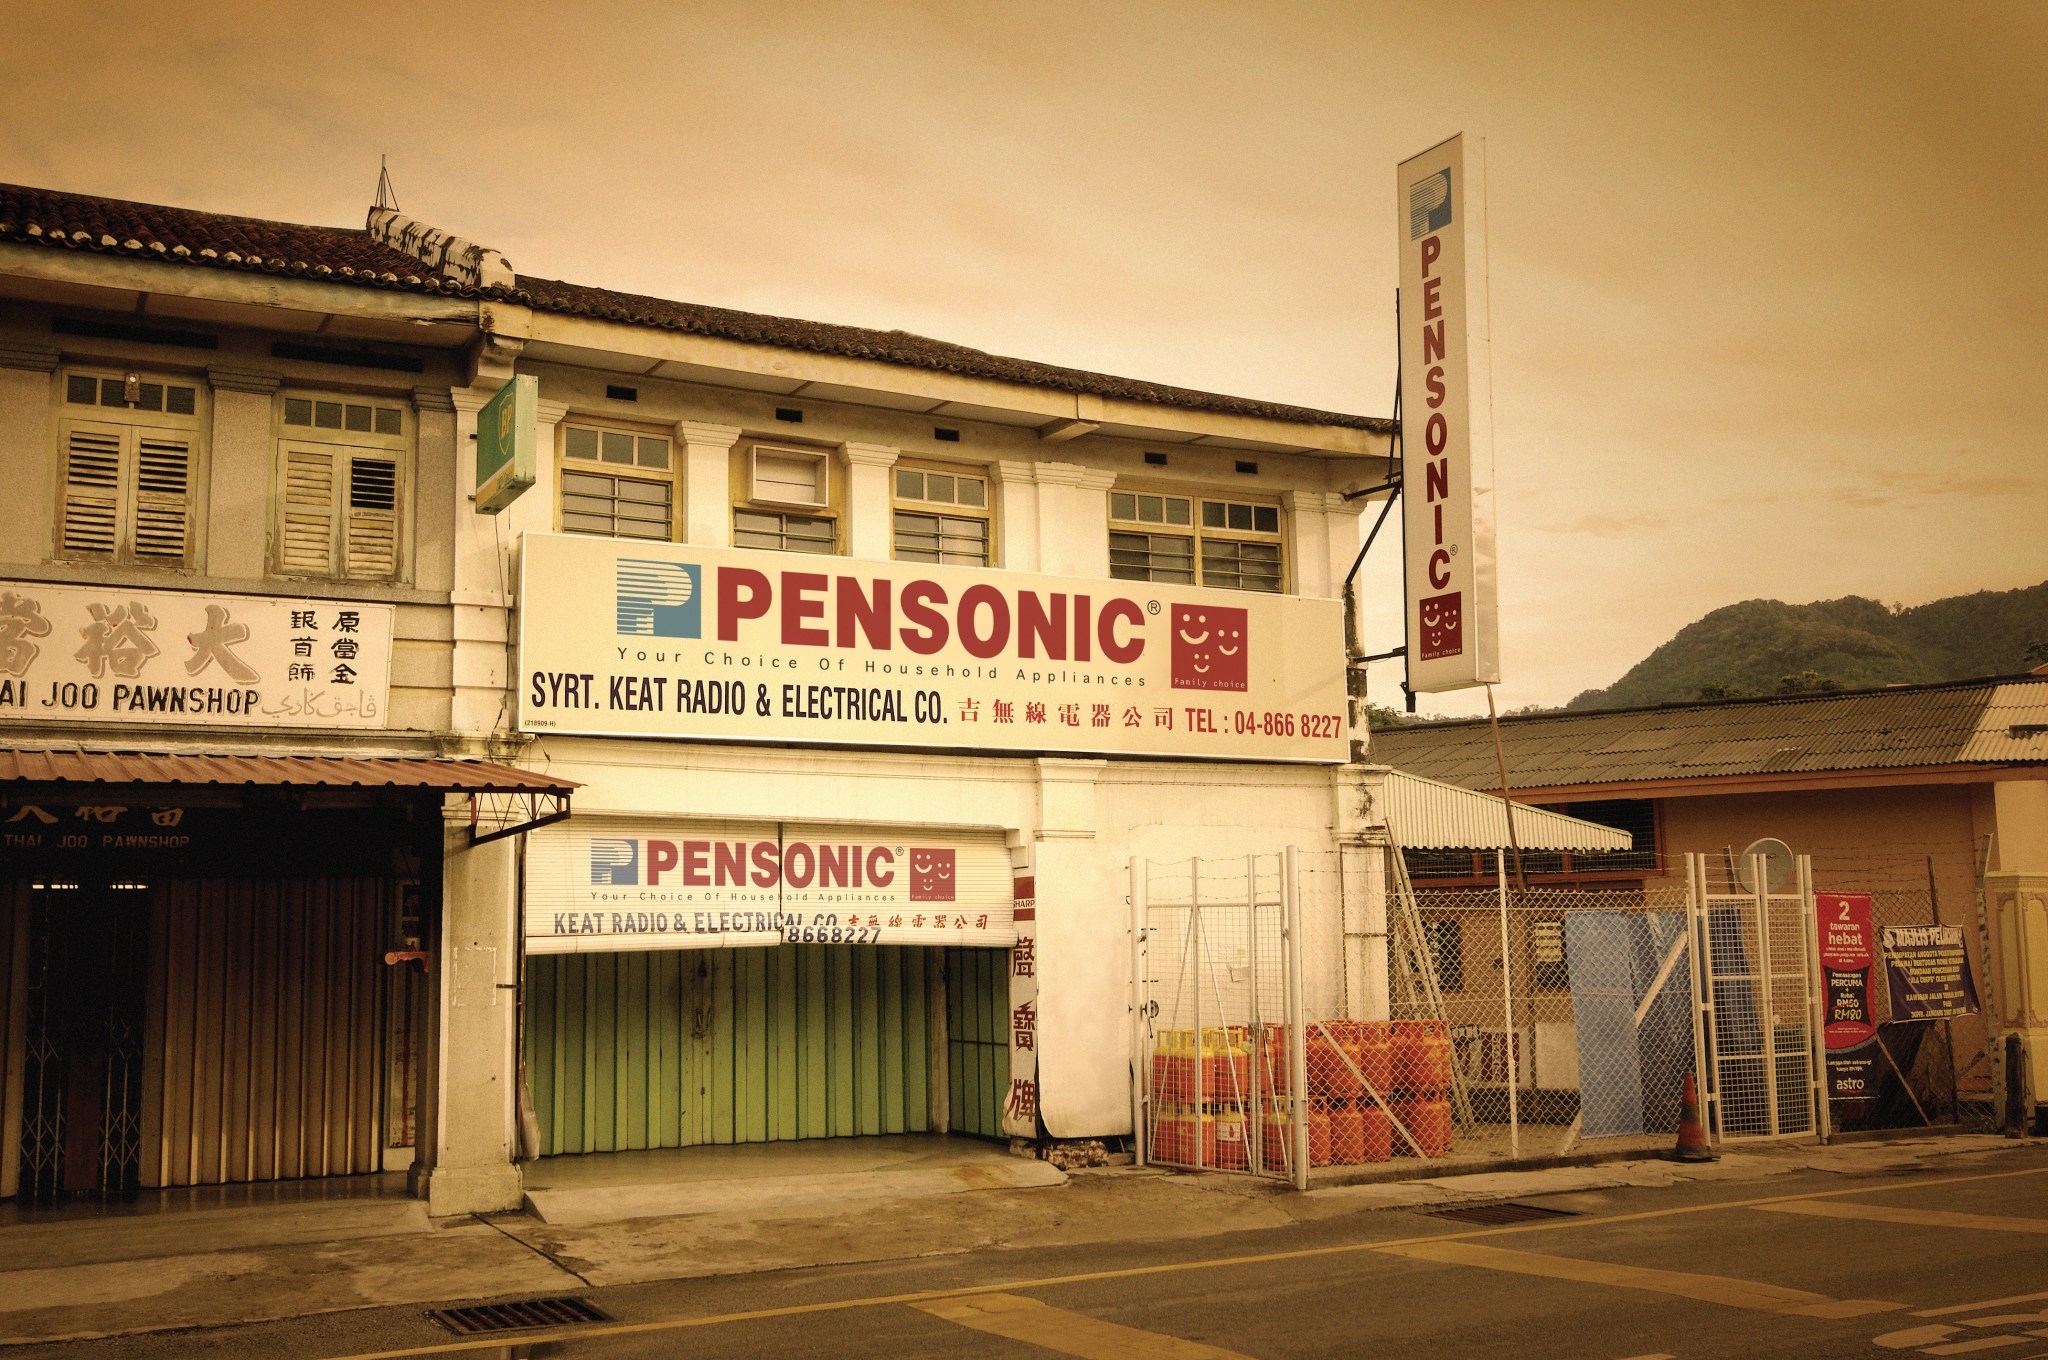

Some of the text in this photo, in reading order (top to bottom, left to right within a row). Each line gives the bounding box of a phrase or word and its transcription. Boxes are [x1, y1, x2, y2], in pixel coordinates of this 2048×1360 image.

[1420, 235, 1451, 590] PENSONIC
[717, 566, 1146, 664] PENSONIC
[1421, 646, 1461, 660] Family choice
[617, 647, 1147, 687] Your Choice Of Household Appliances
[1174, 677, 1246, 689] Family choice
[42, 682, 98, 709] JOO
[113, 684, 260, 716] PAWNSHOP
[531, 671, 949, 724] SYRT. KEAT RADIO & ELECTRICAL CO.
[957, 698, 1175, 731] 吉無線電器公司
[1234, 710, 1295, 738] 04-866
[1300, 713, 1342, 739] 8227
[5, 834, 190, 849] THAI JOO PAWNSHOP
[647, 840, 895, 888] PENSONIC
[591, 892, 628, 901] Your
[639, 892, 692, 901] Choice
[704, 892, 721, 901] Of
[818, 893, 896, 903] Appliances
[1839, 900, 1850, 920] 2
[554, 913, 605, 934] KEAT
[612, 912, 668, 934] RADIO
[672, 912, 688, 933] &
[1829, 922, 1860, 931] tawaran
[787, 926, 881, 943] 8668227
[1828, 931, 1863, 946] hebat
[1831, 979, 1863, 987] PERCUMA
[1834, 1009, 1862, 1020] RM80
[1836, 1077, 1865, 1090] astro
